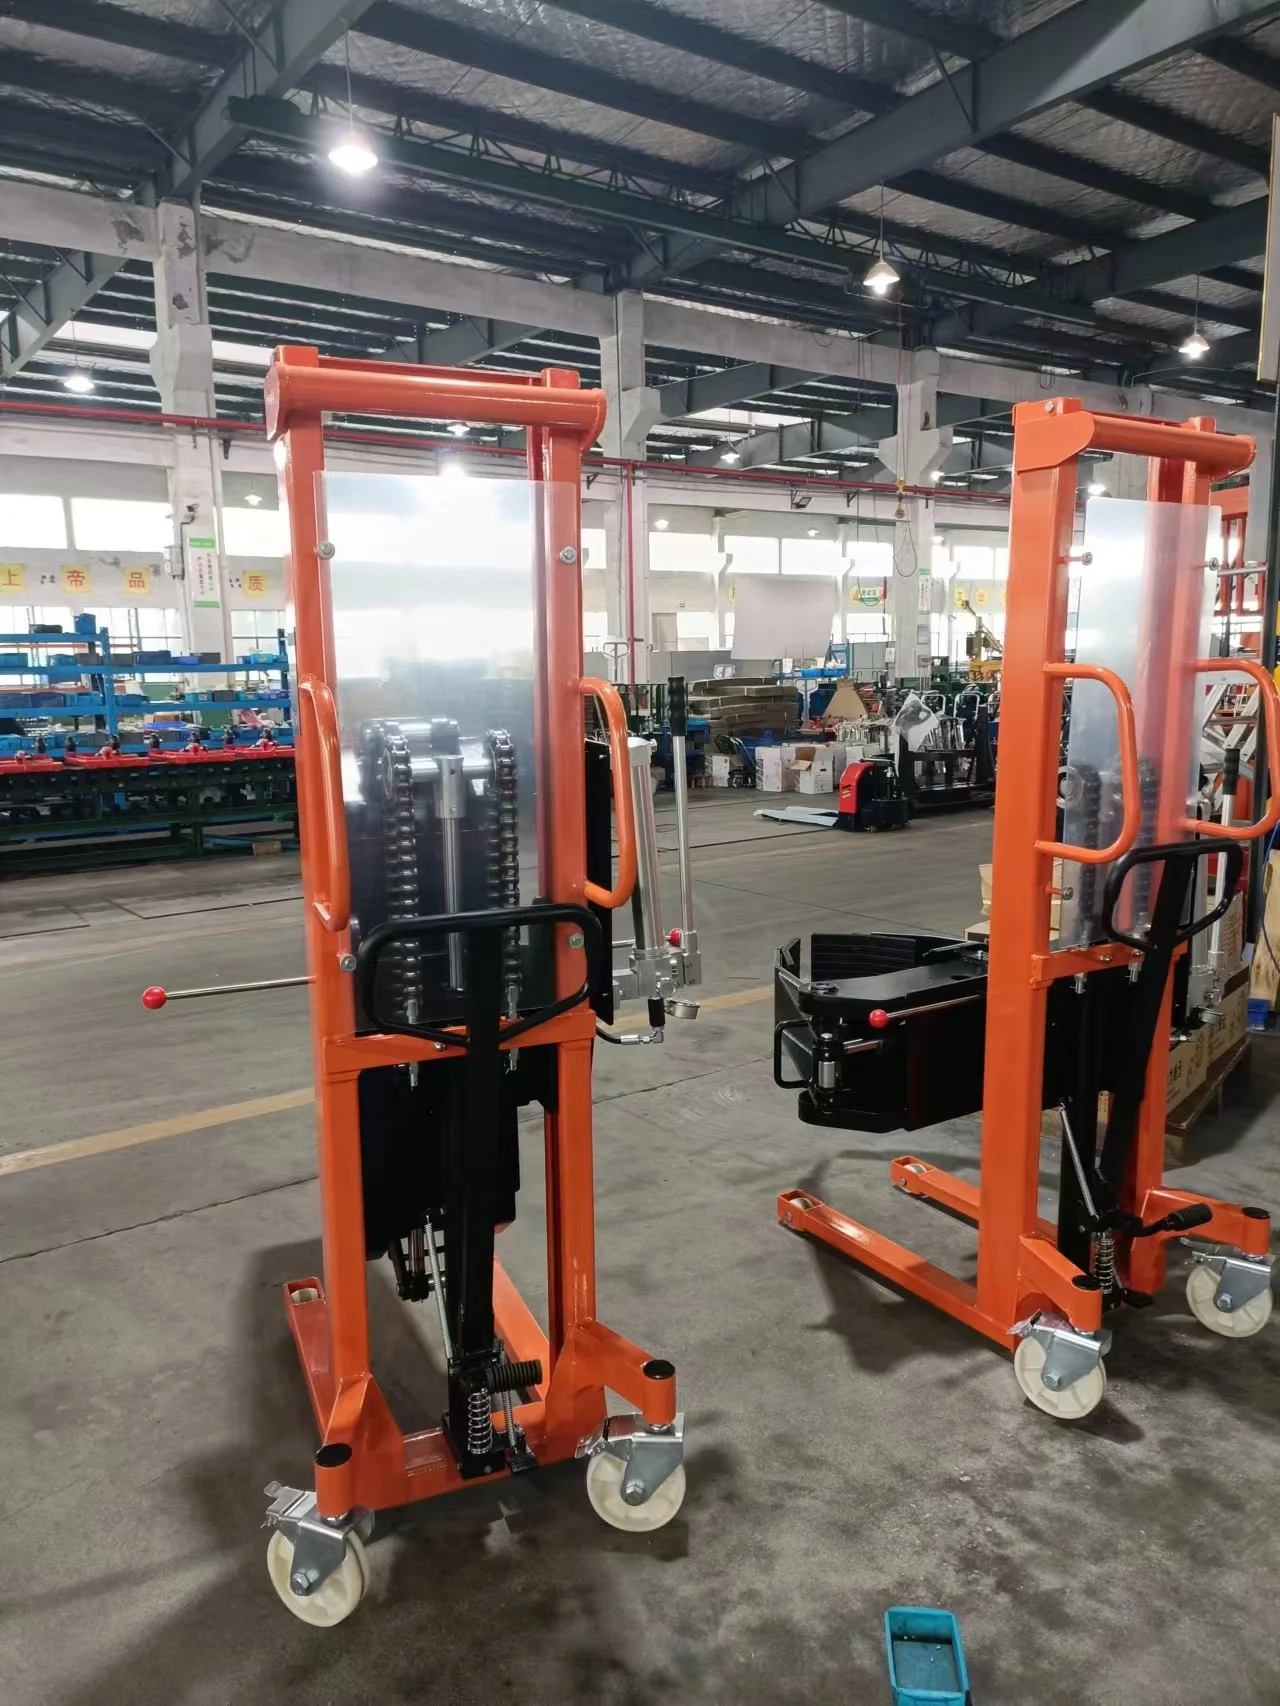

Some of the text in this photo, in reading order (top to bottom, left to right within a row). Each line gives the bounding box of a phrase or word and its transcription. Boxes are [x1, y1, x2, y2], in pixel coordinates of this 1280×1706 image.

[1, 569, 264, 592] 上 帝 品 质
